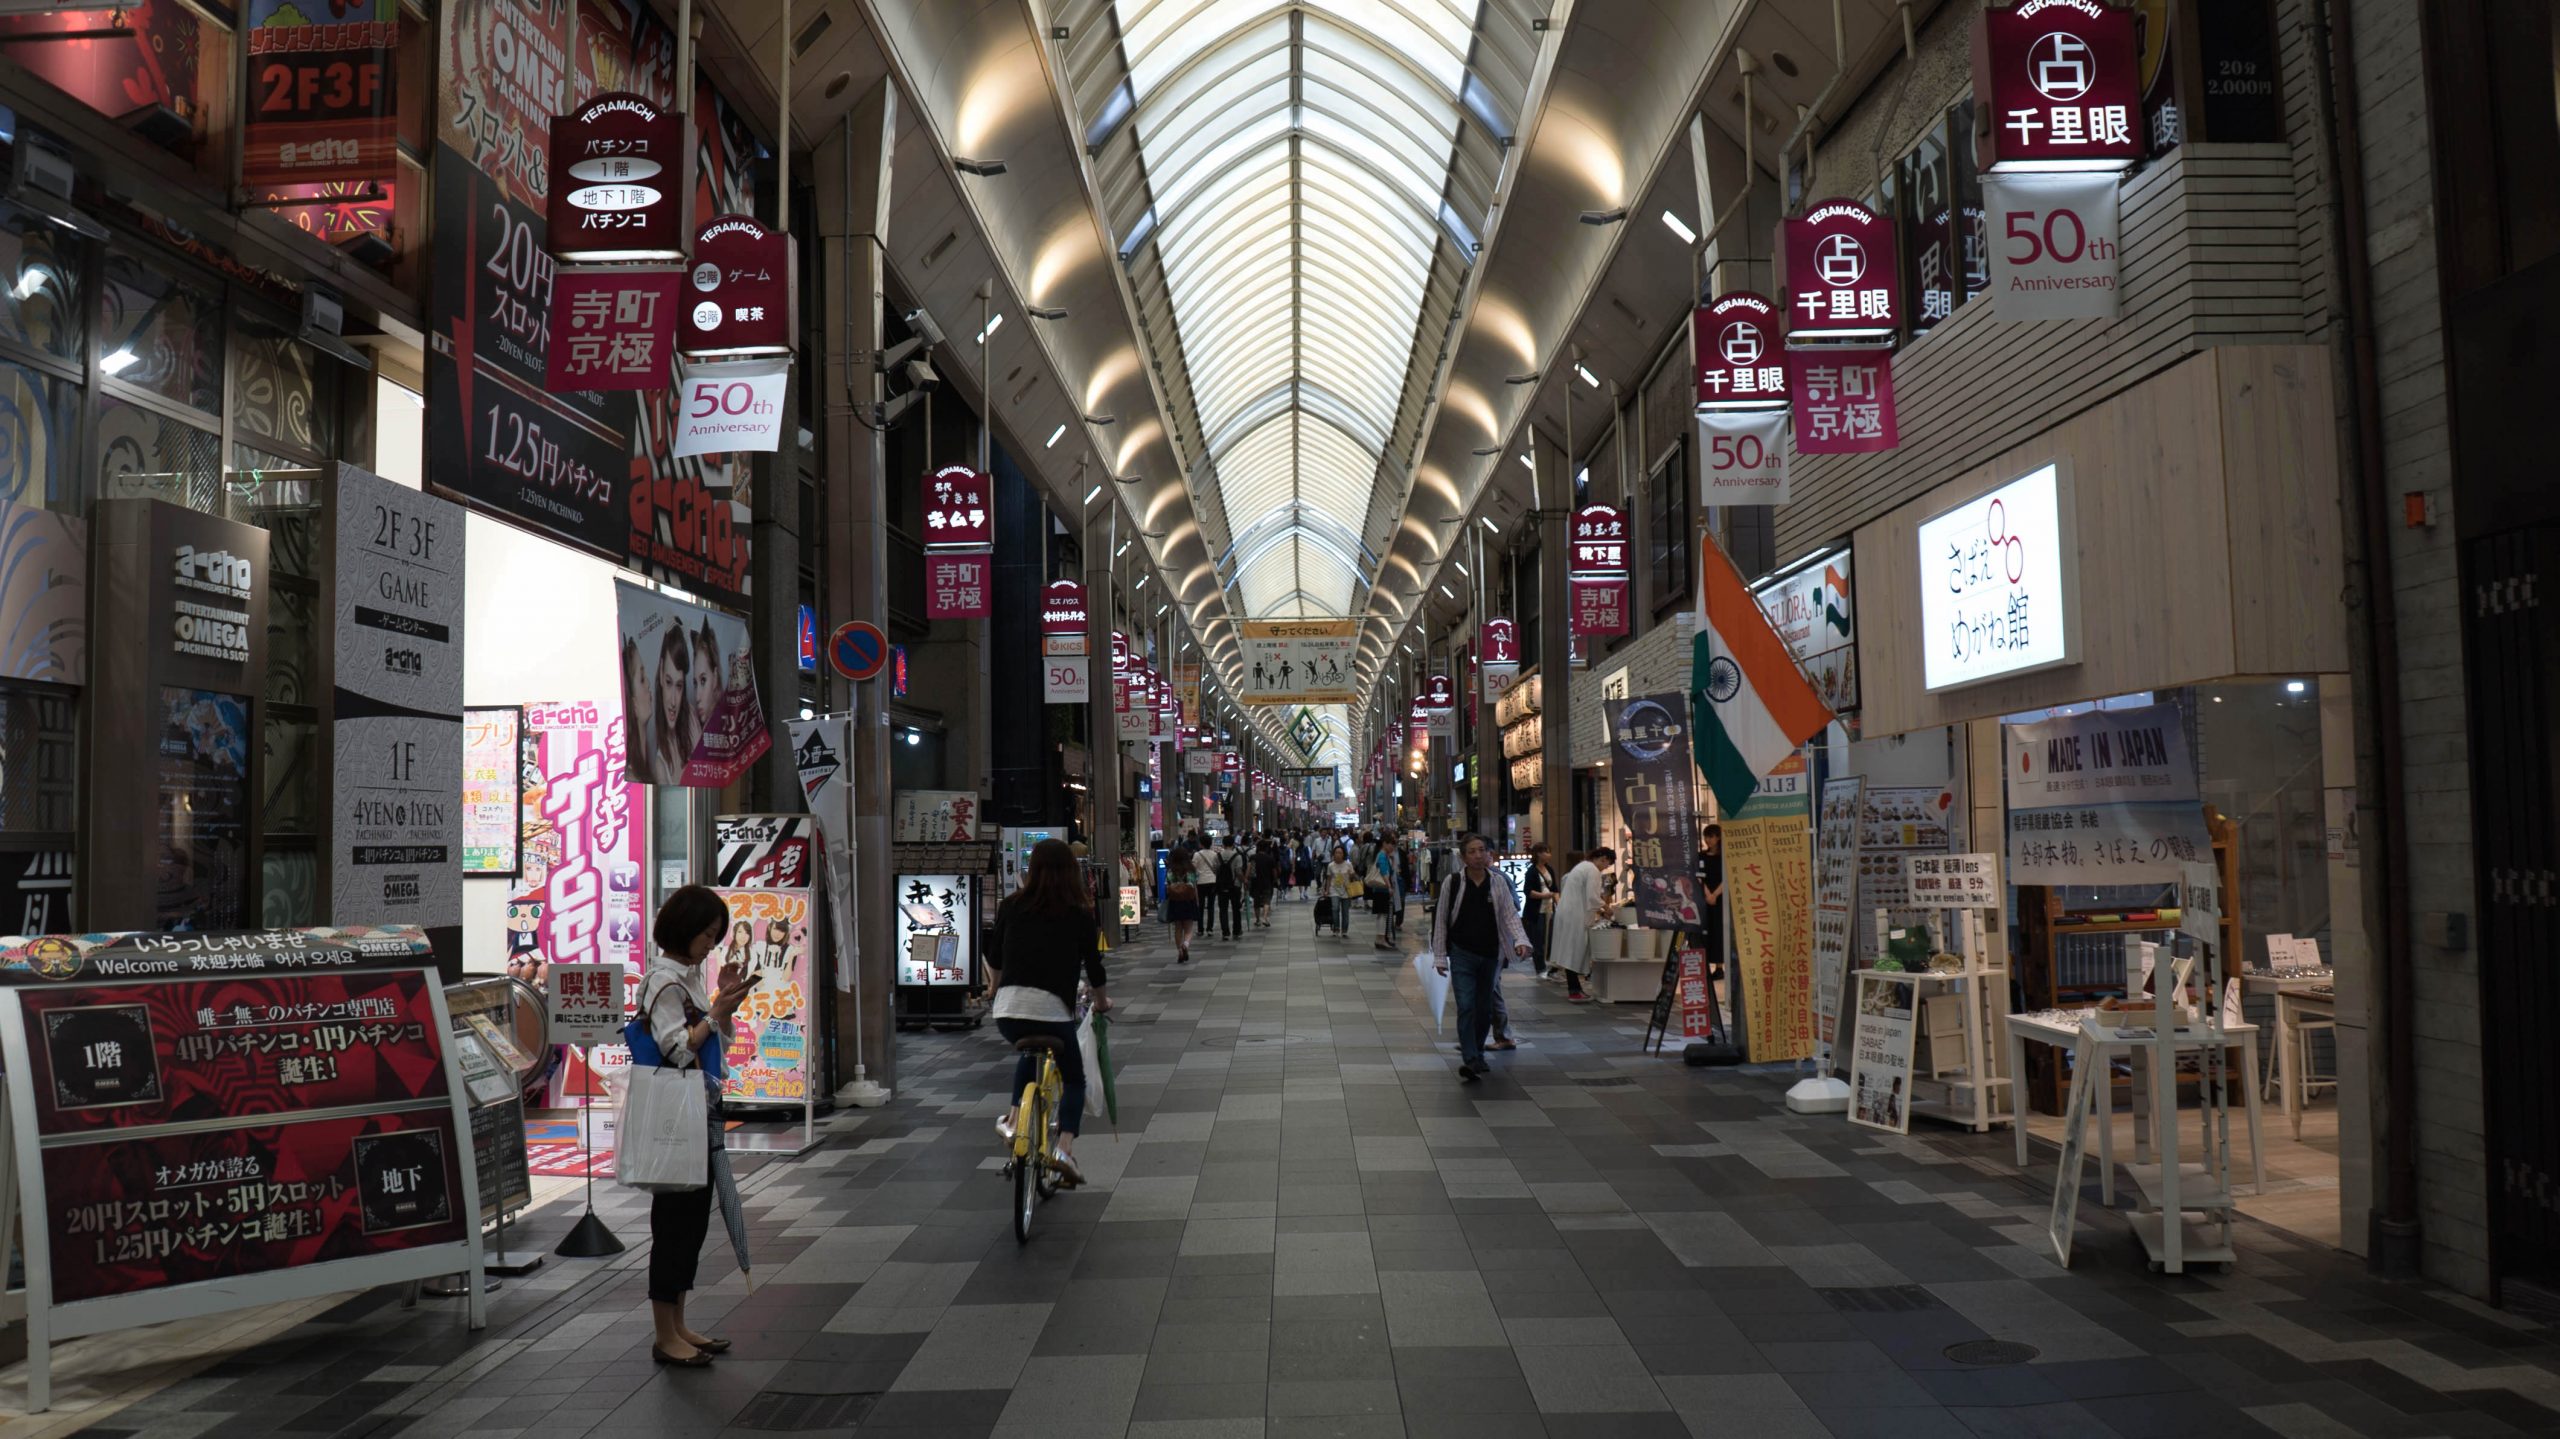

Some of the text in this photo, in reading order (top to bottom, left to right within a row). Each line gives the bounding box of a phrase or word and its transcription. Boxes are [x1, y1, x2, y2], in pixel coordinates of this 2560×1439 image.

[2039, 33, 2085, 93] 占
[581, 100, 656, 126] TERAMACHI
[2005, 105, 2132, 147] 千里眼
[584, 139, 648, 154] パチンコ
[601, 161, 630, 178] 1階
[583, 189, 646, 206] 地下1階
[582, 213, 647, 229] パチンコ
[1806, 204, 1873, 226] TERAMACHI
[700, 221, 764, 244] TERAMACHI
[2005, 207, 2117, 266] 50th
[486, 203, 554, 307] 20円
[1823, 235, 1859, 281] 占
[696, 267, 771, 284] 2階 ゲーム
[2009, 273, 2118, 293] Anniversary
[571, 289, 660, 329] 寺町
[697, 306, 764, 324] 3階 喫茶
[1712, 297, 1770, 316] TERAMACHI
[1796, 289, 1893, 321] 千里眼
[565, 332, 655, 375] 京極
[1726, 322, 1758, 361] 占
[1703, 366, 1786, 394] 千里眼
[1805, 365, 1878, 402] 寺町
[691, 381, 774, 418] 50th
[688, 421, 771, 437] Anniversary
[1807, 403, 1883, 441] 京極
[486, 403, 612, 503] 1.25円パチンコ
[1711, 434, 1783, 471] 50th
[935, 465, 976, 479] TERAMACHI
[1711, 476, 1783, 490] Anniversary
[374, 505, 435, 560] 2F 3F
[927, 509, 985, 529] キムラ
[176, 545, 251, 590] a-cho
[936, 562, 982, 587] 寺町
[1948, 538, 1994, 594] さばえ
[379, 572, 429, 609] GAME
[935, 587, 982, 610] 京極
[1580, 587, 1620, 607] 寺町
[1580, 608, 1620, 628] 京極
[1951, 586, 2030, 664] めがね館
[175, 616, 248, 650] OMEGA
[1060, 641, 1082, 651] KICS
[1050, 667, 1086, 686] 50th
[531, 706, 599, 724] a-cho
[390, 740, 416, 781] 1F
[2047, 726, 2168, 774] MADE IN JAPAN
[383, 883, 420, 898] OMEGA
[136, 932, 306, 954] いらっしゃいませ
[359, 939, 412, 953] OMEGA
[95, 950, 357, 977] Welcome 欢迎光临 어서 오세요
[560, 971, 612, 996] 喫煙
[1681, 951, 1707, 1034] 営業中
[197, 997, 396, 1028] 唯一無二のパチンコ専門店
[561, 997, 611, 1009] スペース
[84, 1041, 123, 1070] 1階
[279, 1056, 338, 1086] 誕生!
[741, 1068, 778, 1078] GAME
[155, 1154, 261, 1187] オメガが誇る
[381, 1165, 424, 1194] 地下
